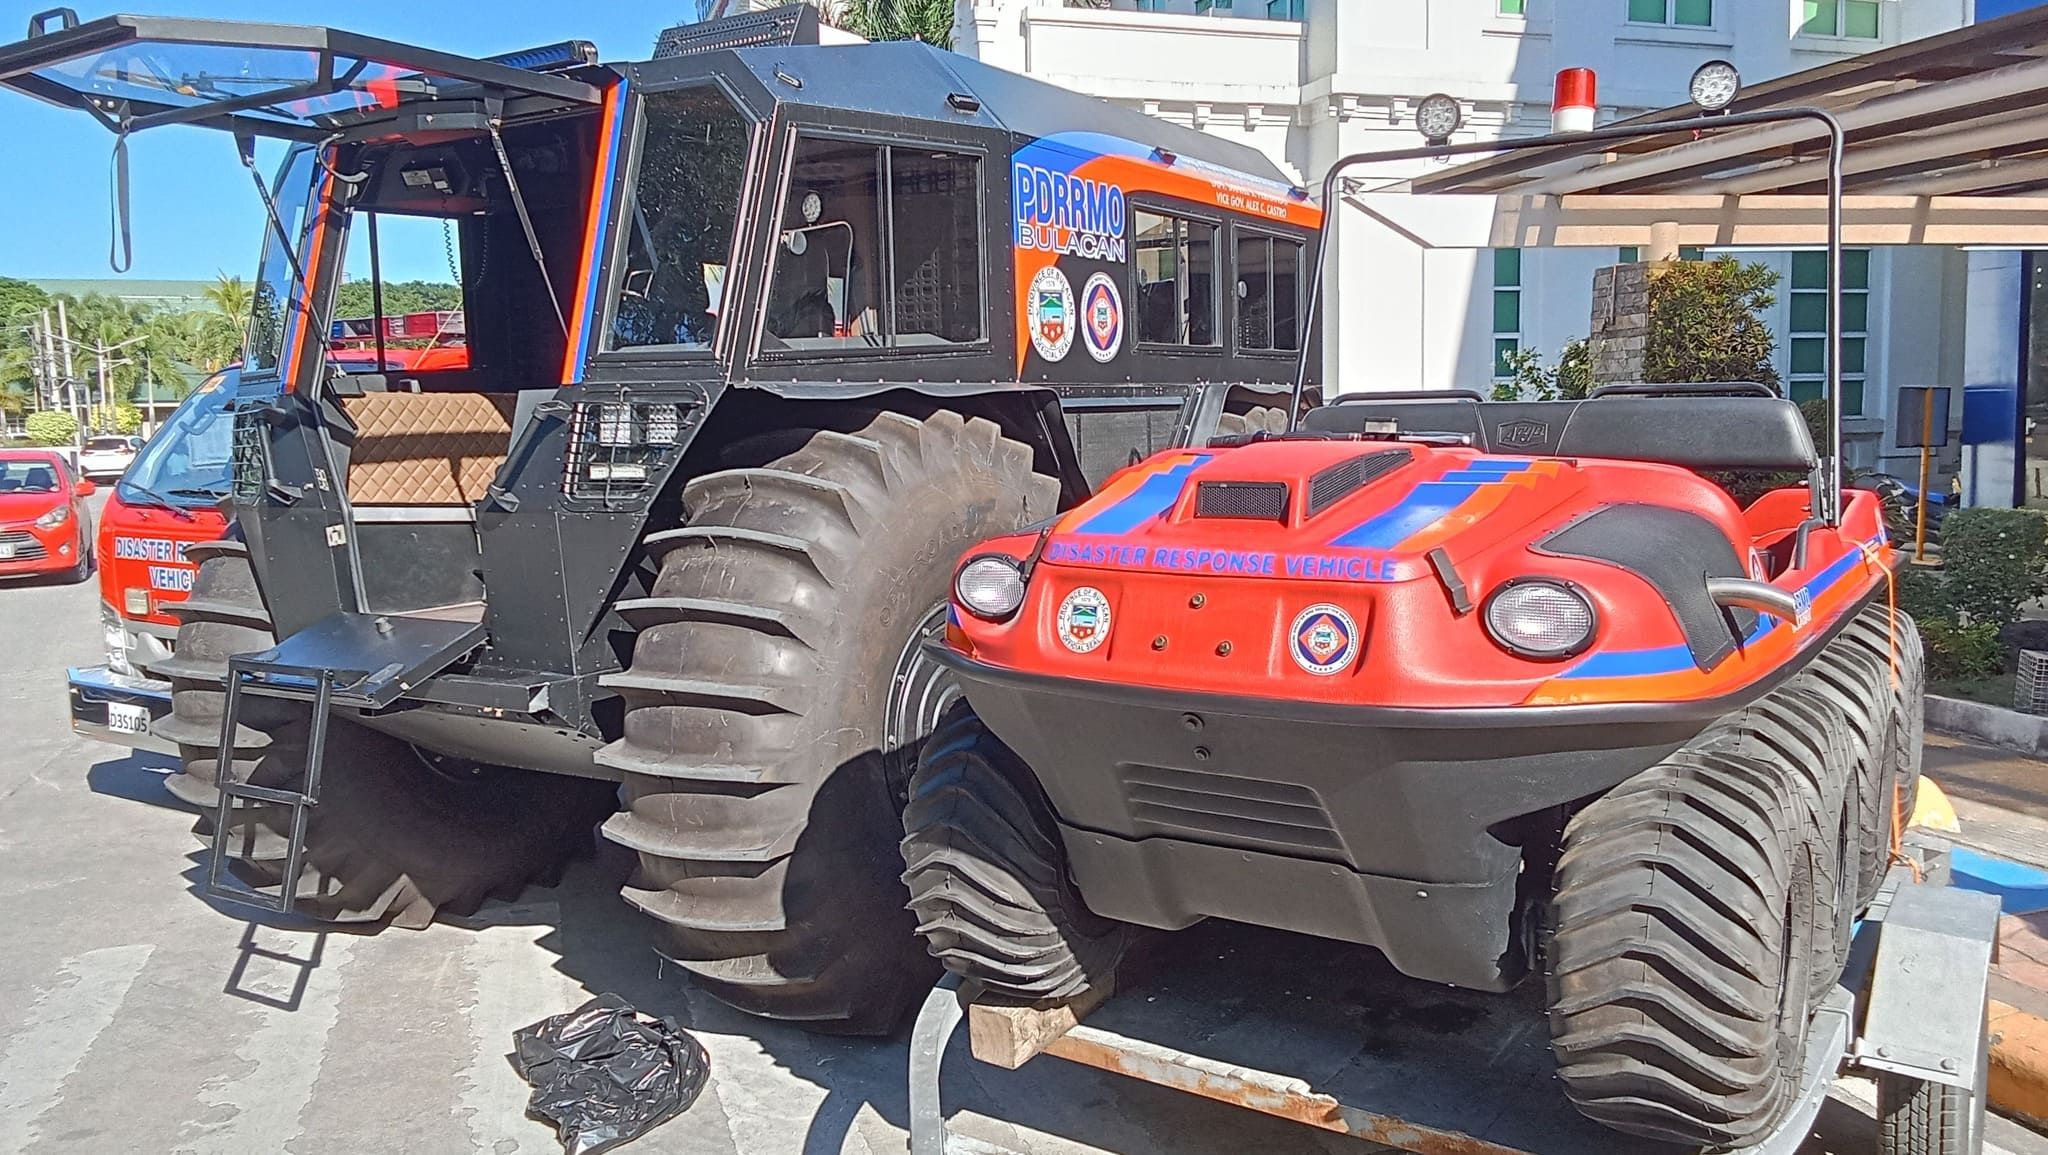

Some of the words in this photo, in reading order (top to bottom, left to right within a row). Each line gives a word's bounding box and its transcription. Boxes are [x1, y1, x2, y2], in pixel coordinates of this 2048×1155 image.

[1015, 162, 1125, 239] PDRRMO
[1216, 192, 1230, 205] VICE
[1231, 195, 1244, 209] GOV.
[1246, 199, 1260, 212] ALEX
[1267, 204, 1287, 219] CASTRO
[1019, 222, 1126, 263] BULACAN
[1028, 270, 1045, 316] PROVINCE
[115, 537, 173, 562] DISASTER
[1049, 543, 1148, 566] DISASTER
[1153, 547, 1277, 575] RESPONSE
[1285, 554, 1398, 582] VEHICLE
[1059, 589, 1081, 620] PROVINCE
